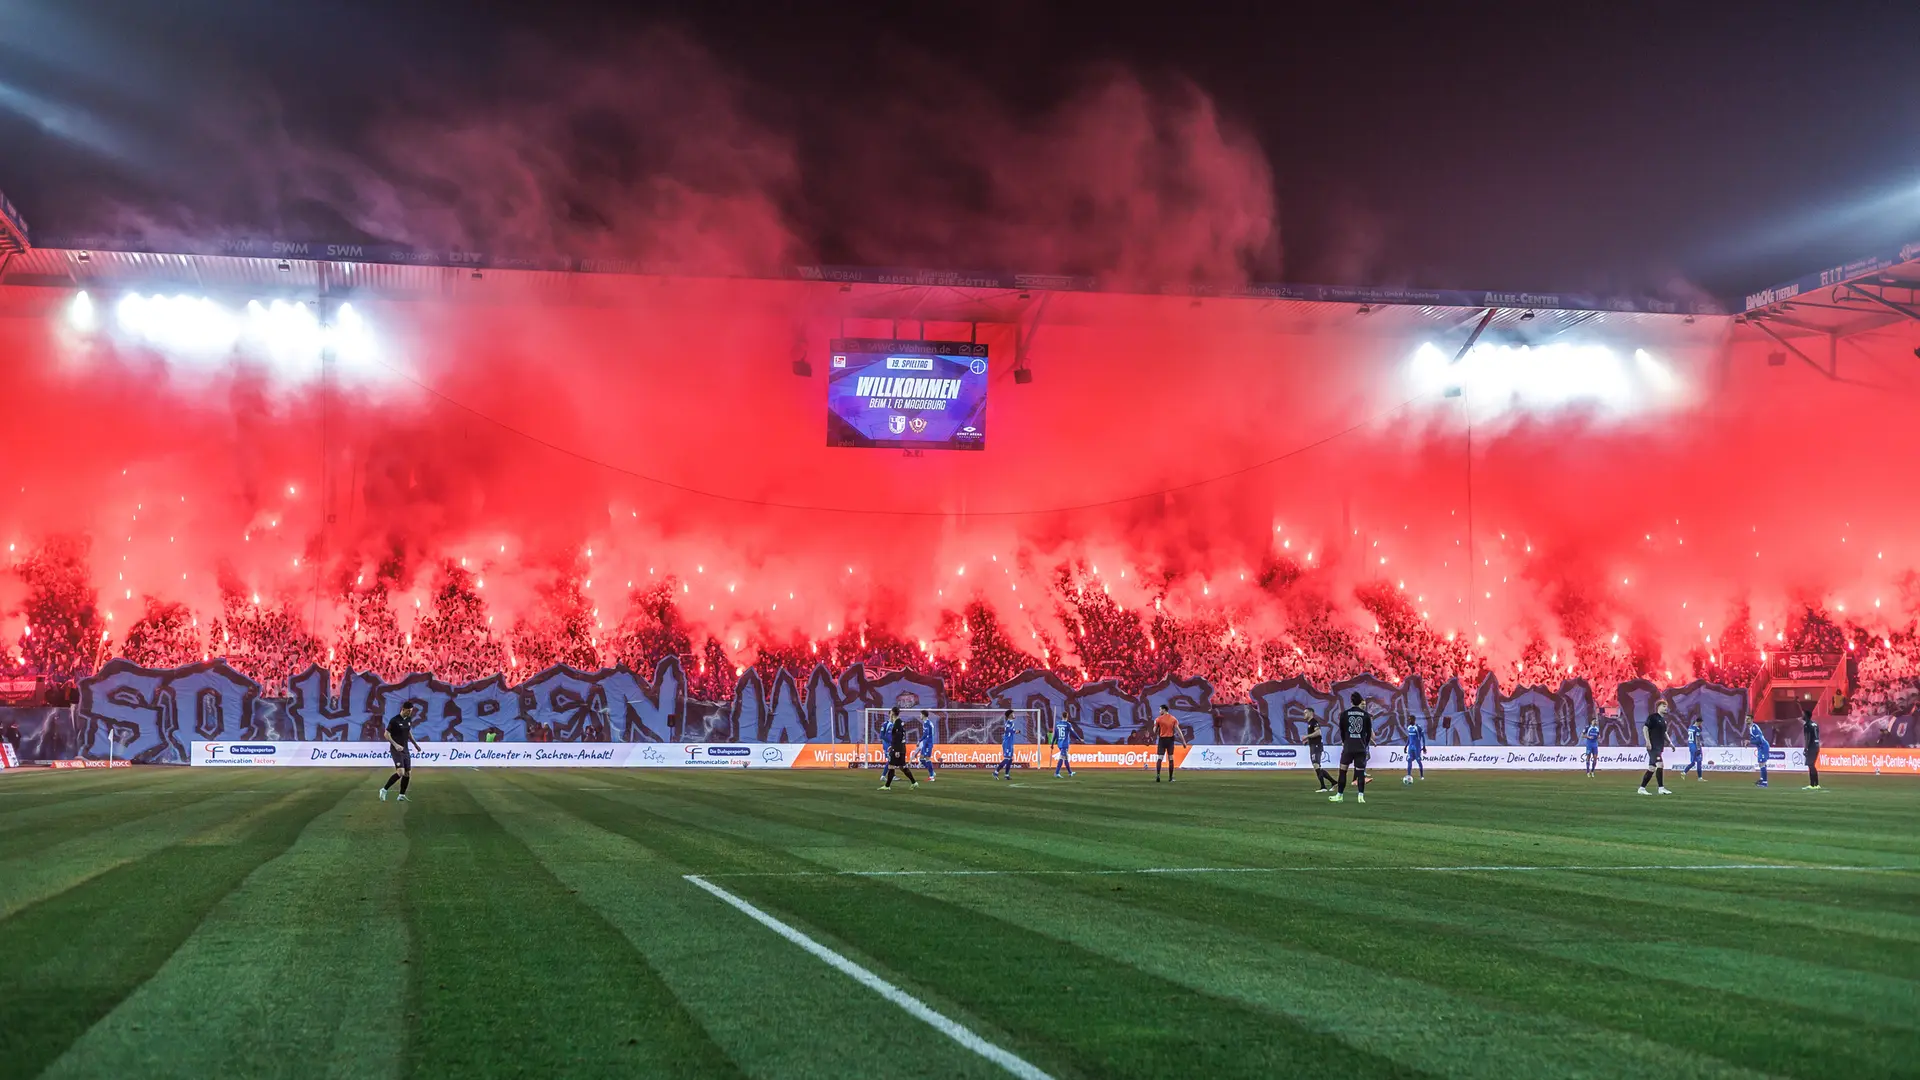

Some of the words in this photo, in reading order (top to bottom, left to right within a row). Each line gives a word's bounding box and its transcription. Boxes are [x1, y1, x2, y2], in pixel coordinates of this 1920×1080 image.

[272, 241, 309, 254] SWM
[327, 244, 363, 257] SWM
[879, 275, 912, 284] BADEN
[901, 360, 928, 369] SPIELTAG
[856, 376, 961, 399] WILLKOMMEN
[869, 398, 886, 409] BEIM
[893, 399, 902, 409] FC
[904, 399, 946, 410] MAGDEBURG
[78, 658, 262, 769] SO
[287, 653, 689, 743] HABEN
[1057, 726, 1066, 738] 16
[311, 748, 327, 760] Die
[449, 748, 471, 761] Dein
[474, 748, 519, 760] Callcenter
[523, 749, 532, 760] in
[535, 748, 614, 760] Sachsen-Anhalt!
[814, 750, 833, 762] Wir
[834, 749, 873, 762] suchen
[1390, 752, 1403, 763] Die
[1468, 752, 1499, 764] Factory
[1507, 752, 1526, 764] Dein
[1528, 752, 1567, 763] Callcenter
[1569, 754, 1577, 763] in
[1820, 754, 1830, 766] Wir
[1831, 754, 1853, 766] suchen
[1852, 754, 1867, 766] Dich!
[253, 757, 276, 765] factory
